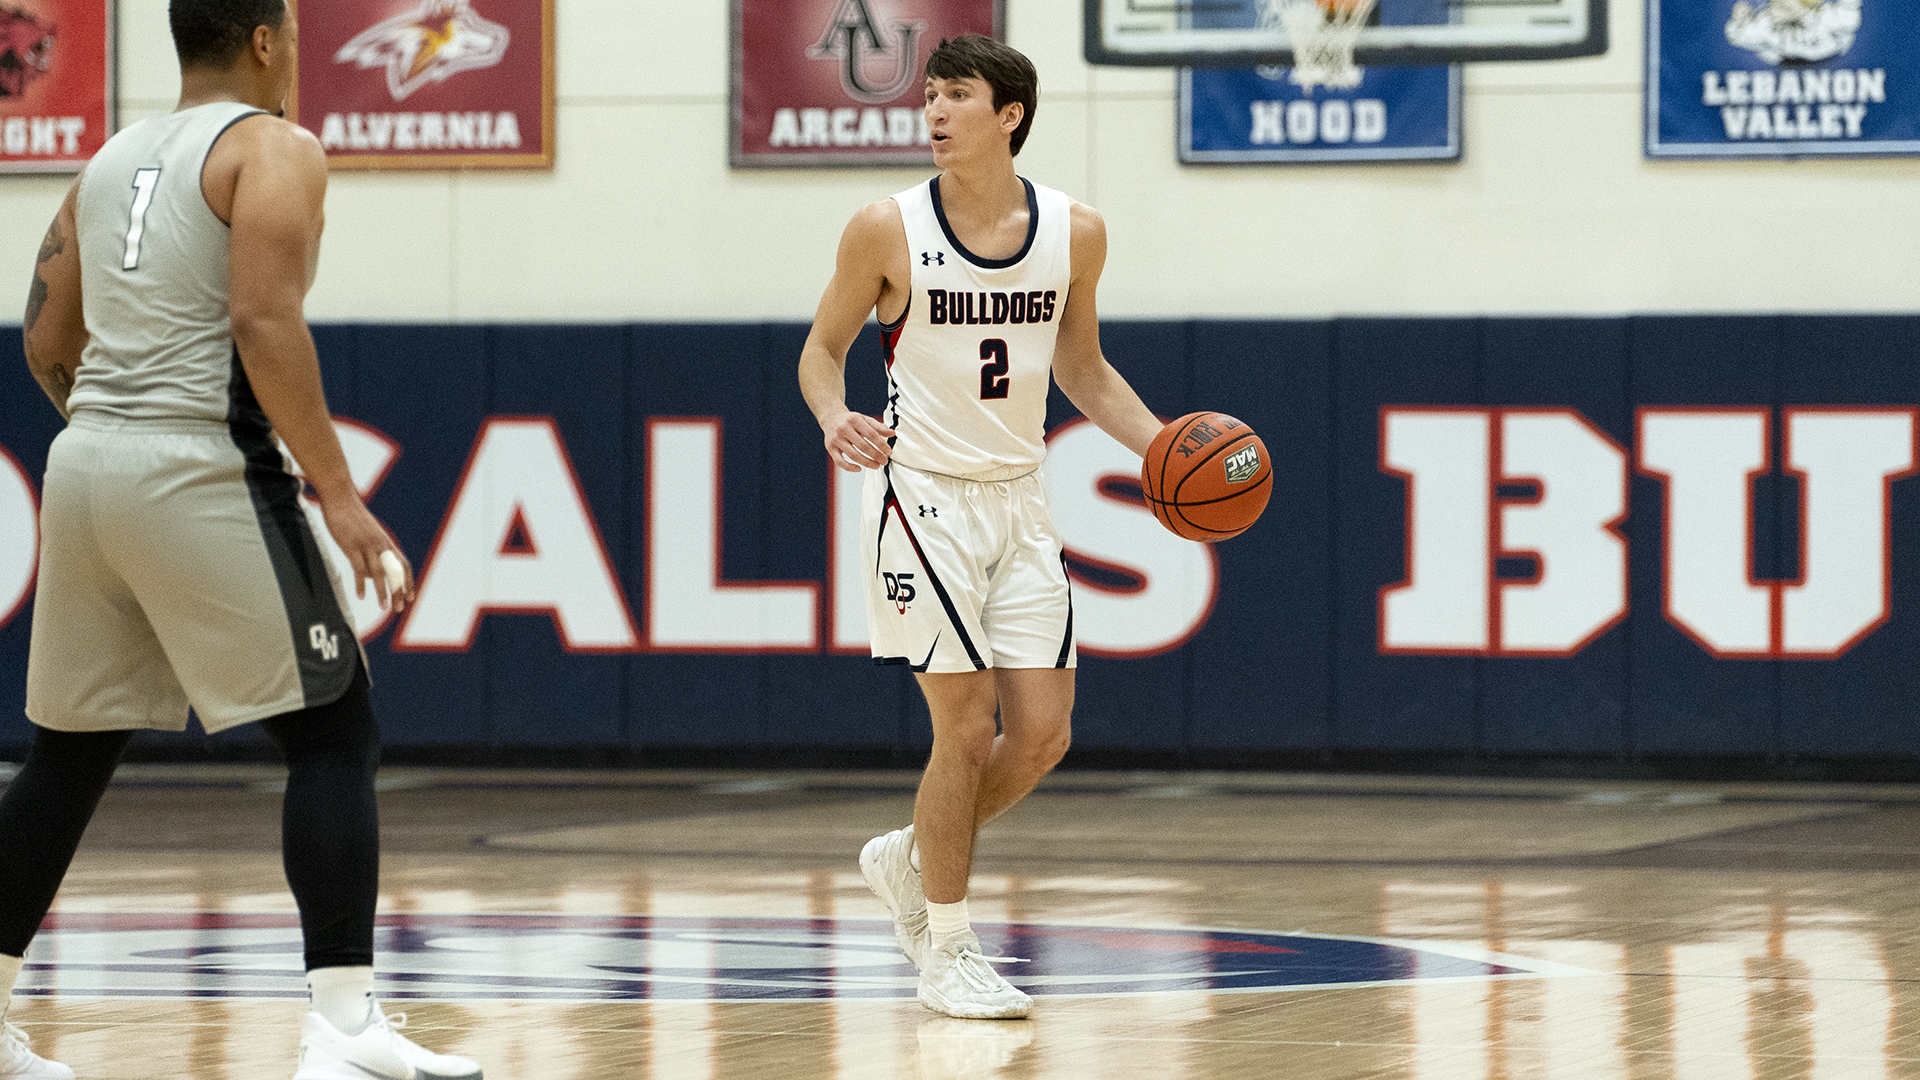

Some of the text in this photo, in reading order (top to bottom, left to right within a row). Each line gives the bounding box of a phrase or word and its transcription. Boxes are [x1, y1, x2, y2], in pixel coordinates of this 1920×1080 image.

[805, 0, 929, 104] AU
[1702, 68, 1886, 106] LEBANON
[0, 115, 86, 155] GHT
[320, 111, 522, 149] ALVERNIA
[1249, 98, 1387, 145] HOOD
[1721, 103, 1867, 139] VALLEY
[121, 167, 162, 272] 1
[927, 289, 1057, 325] BULLDOGS
[979, 338, 1010, 400] 2
[1176, 421, 1223, 458] ROCK
[1226, 446, 1257, 473] MAC
[276, 412, 1221, 658] ALS
